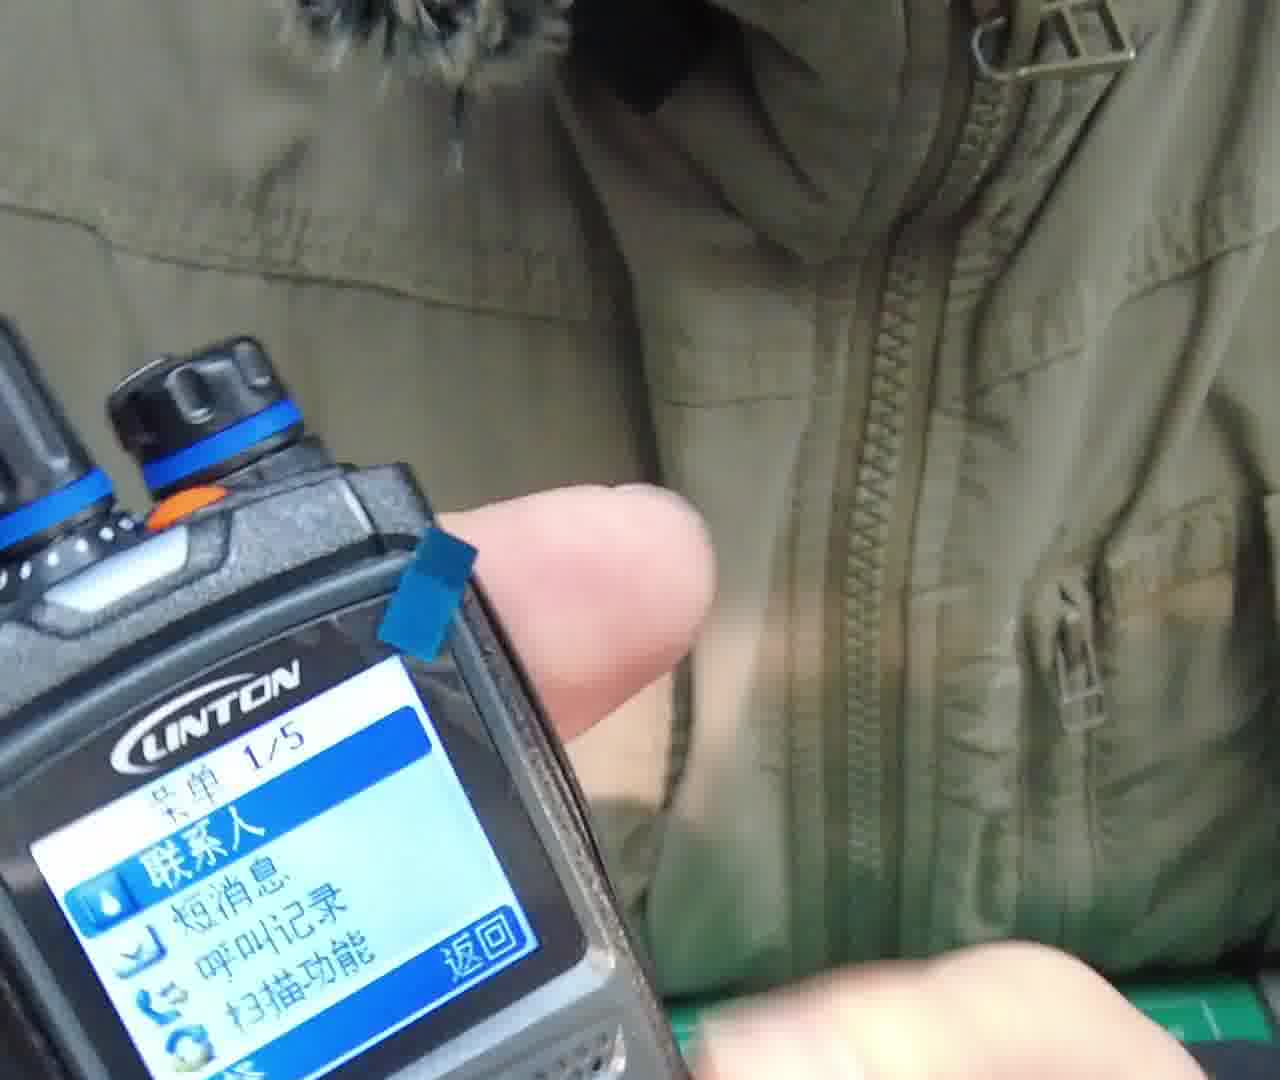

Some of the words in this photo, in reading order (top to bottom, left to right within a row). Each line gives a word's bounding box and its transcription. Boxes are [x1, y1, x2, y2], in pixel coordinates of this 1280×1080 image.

[141, 658, 302, 763] LINTON
[242, 723, 306, 773] 1/5
[139, 804, 266, 889] 联系人
[171, 855, 291, 938] 短消息
[195, 881, 349, 986] 呼叫记录
[224, 931, 377, 1035] 扫描功能
[442, 914, 524, 983] 返回
